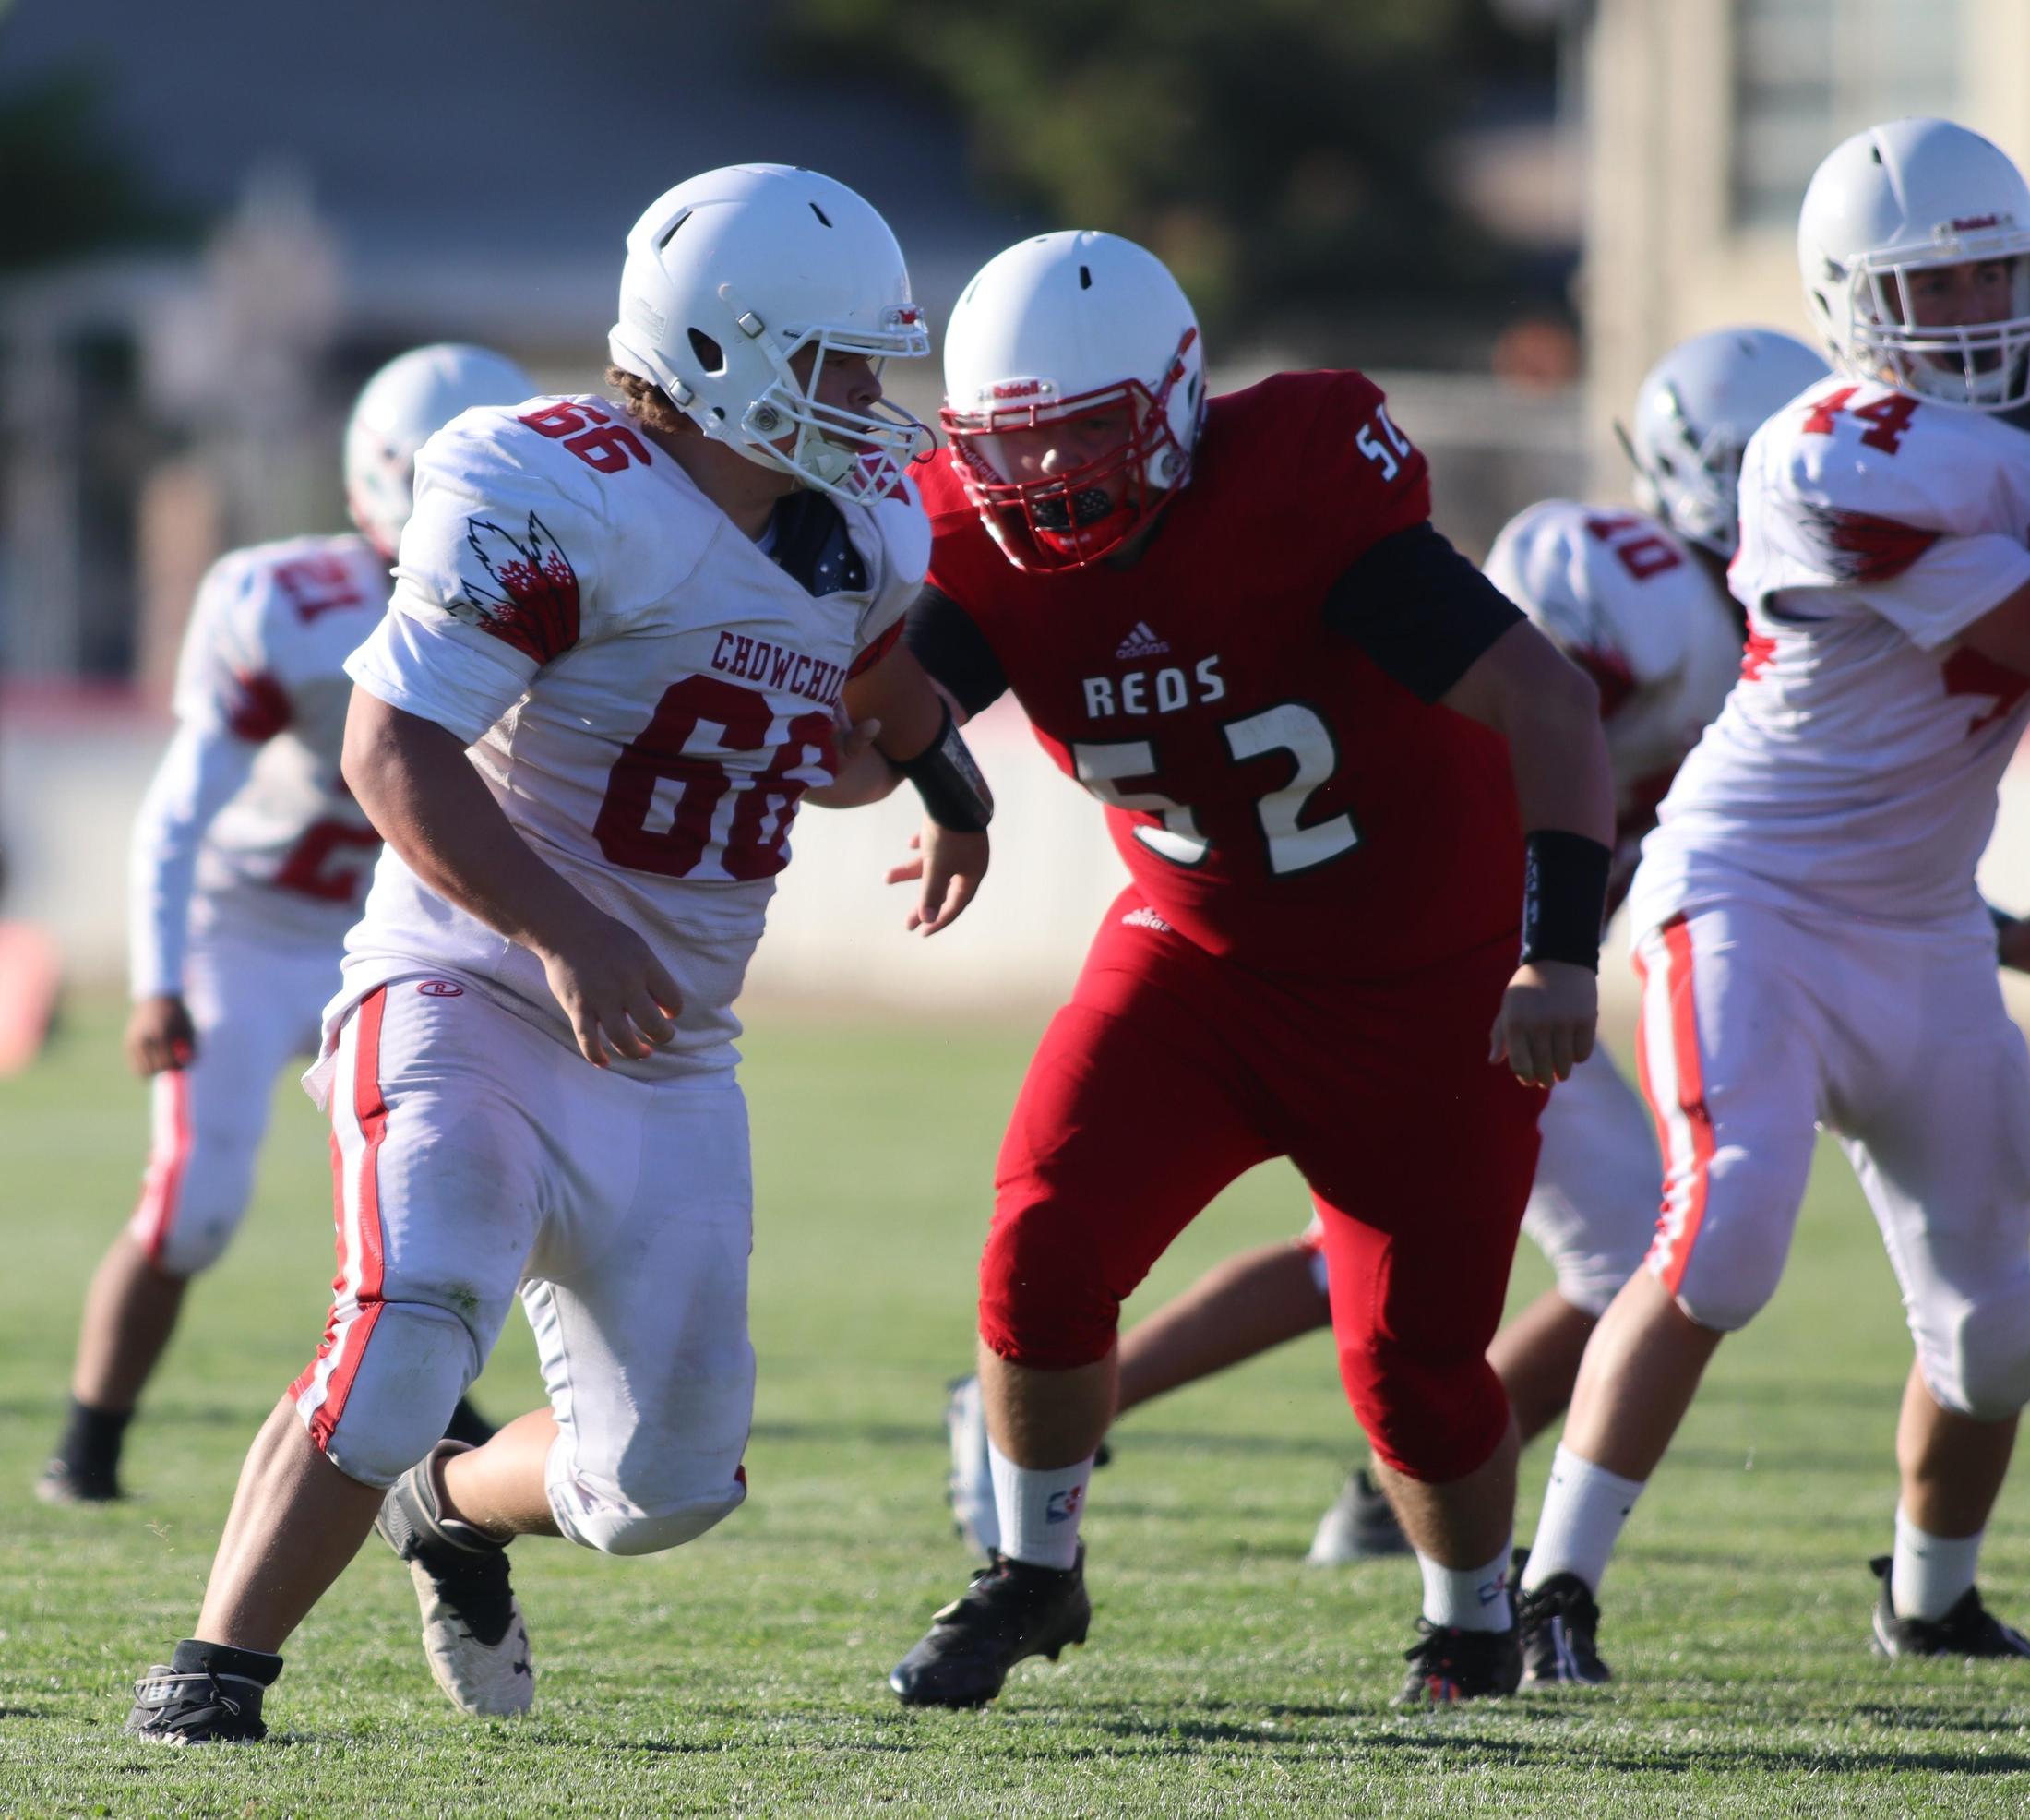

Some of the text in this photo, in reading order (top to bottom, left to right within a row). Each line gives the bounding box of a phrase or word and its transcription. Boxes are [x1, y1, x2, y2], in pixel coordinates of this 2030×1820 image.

[517, 401, 651, 474] 66
[1082, 653, 1225, 720] REDS
[1116, 641, 1170, 659] adidas
[591, 673, 838, 881] 66
[1070, 702, 1360, 875] 52
